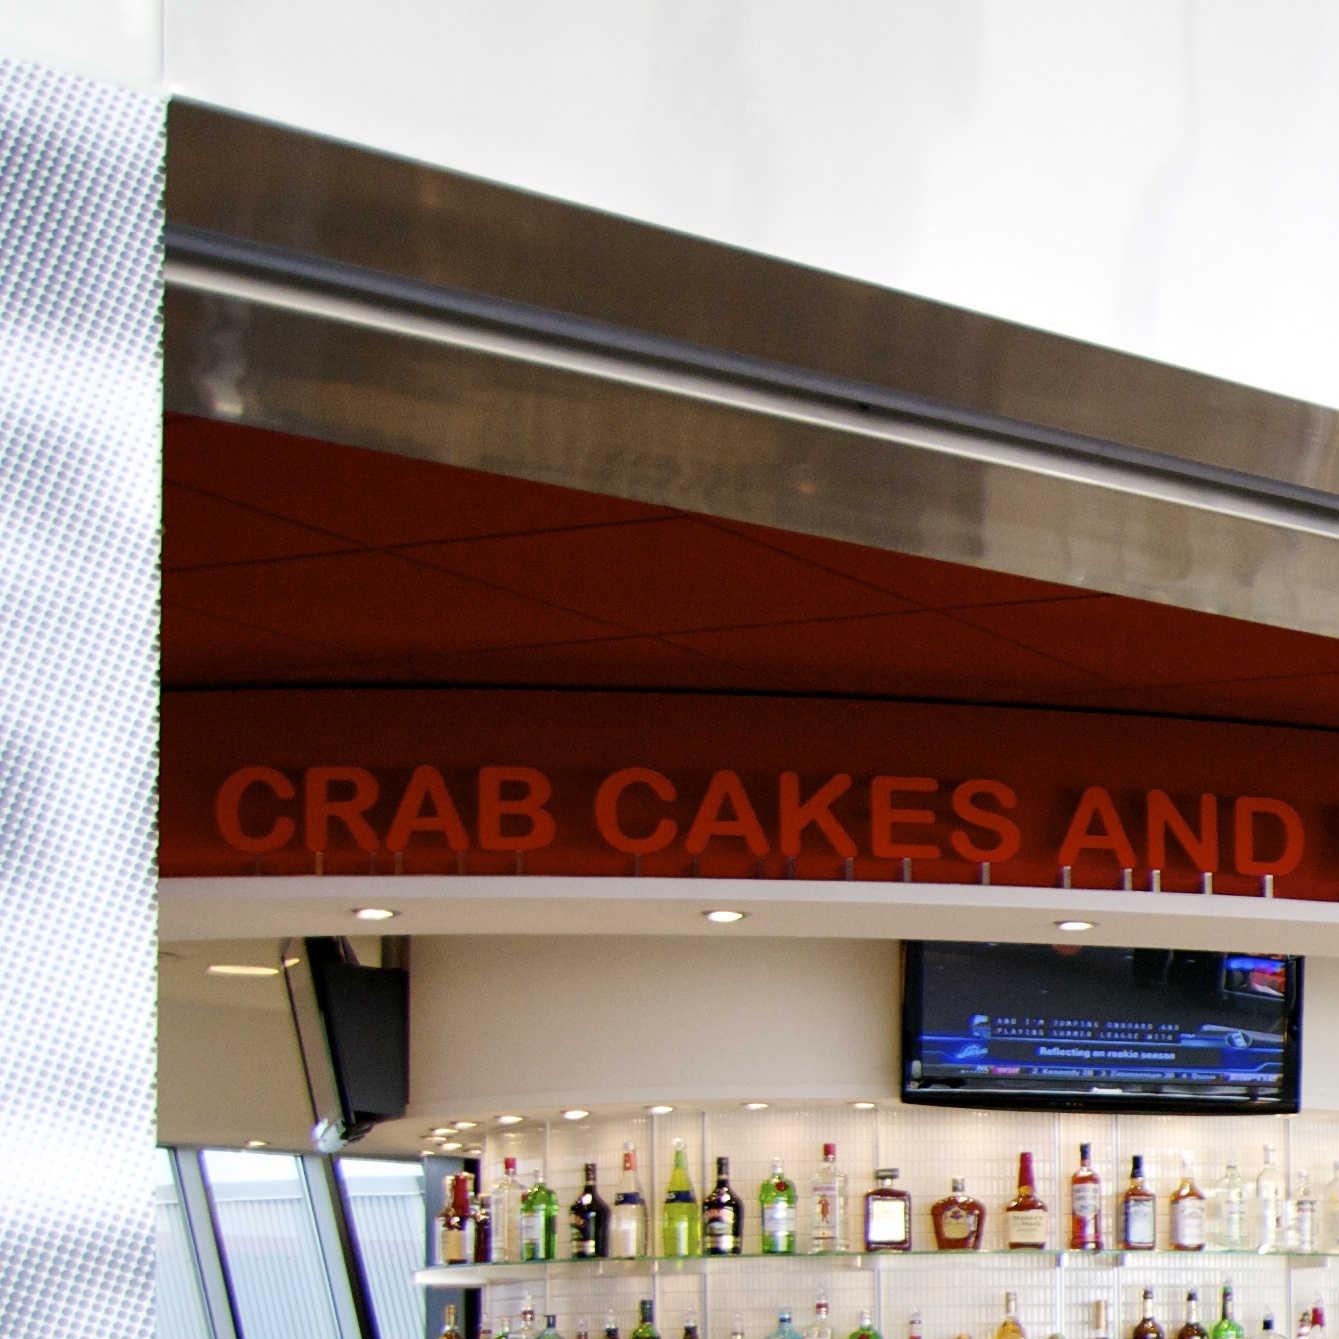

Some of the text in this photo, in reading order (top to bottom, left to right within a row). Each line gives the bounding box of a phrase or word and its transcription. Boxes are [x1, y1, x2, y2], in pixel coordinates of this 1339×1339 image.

[215, 766, 555, 854] CRAB
[597, 768, 1021, 863] CAKES
[1058, 787, 1304, 876] AND
[1039, 1046, 1090, 1059] Reflecting
[1092, 1050, 1105, 1058] on
[1107, 1049, 1139, 1059] rookie
